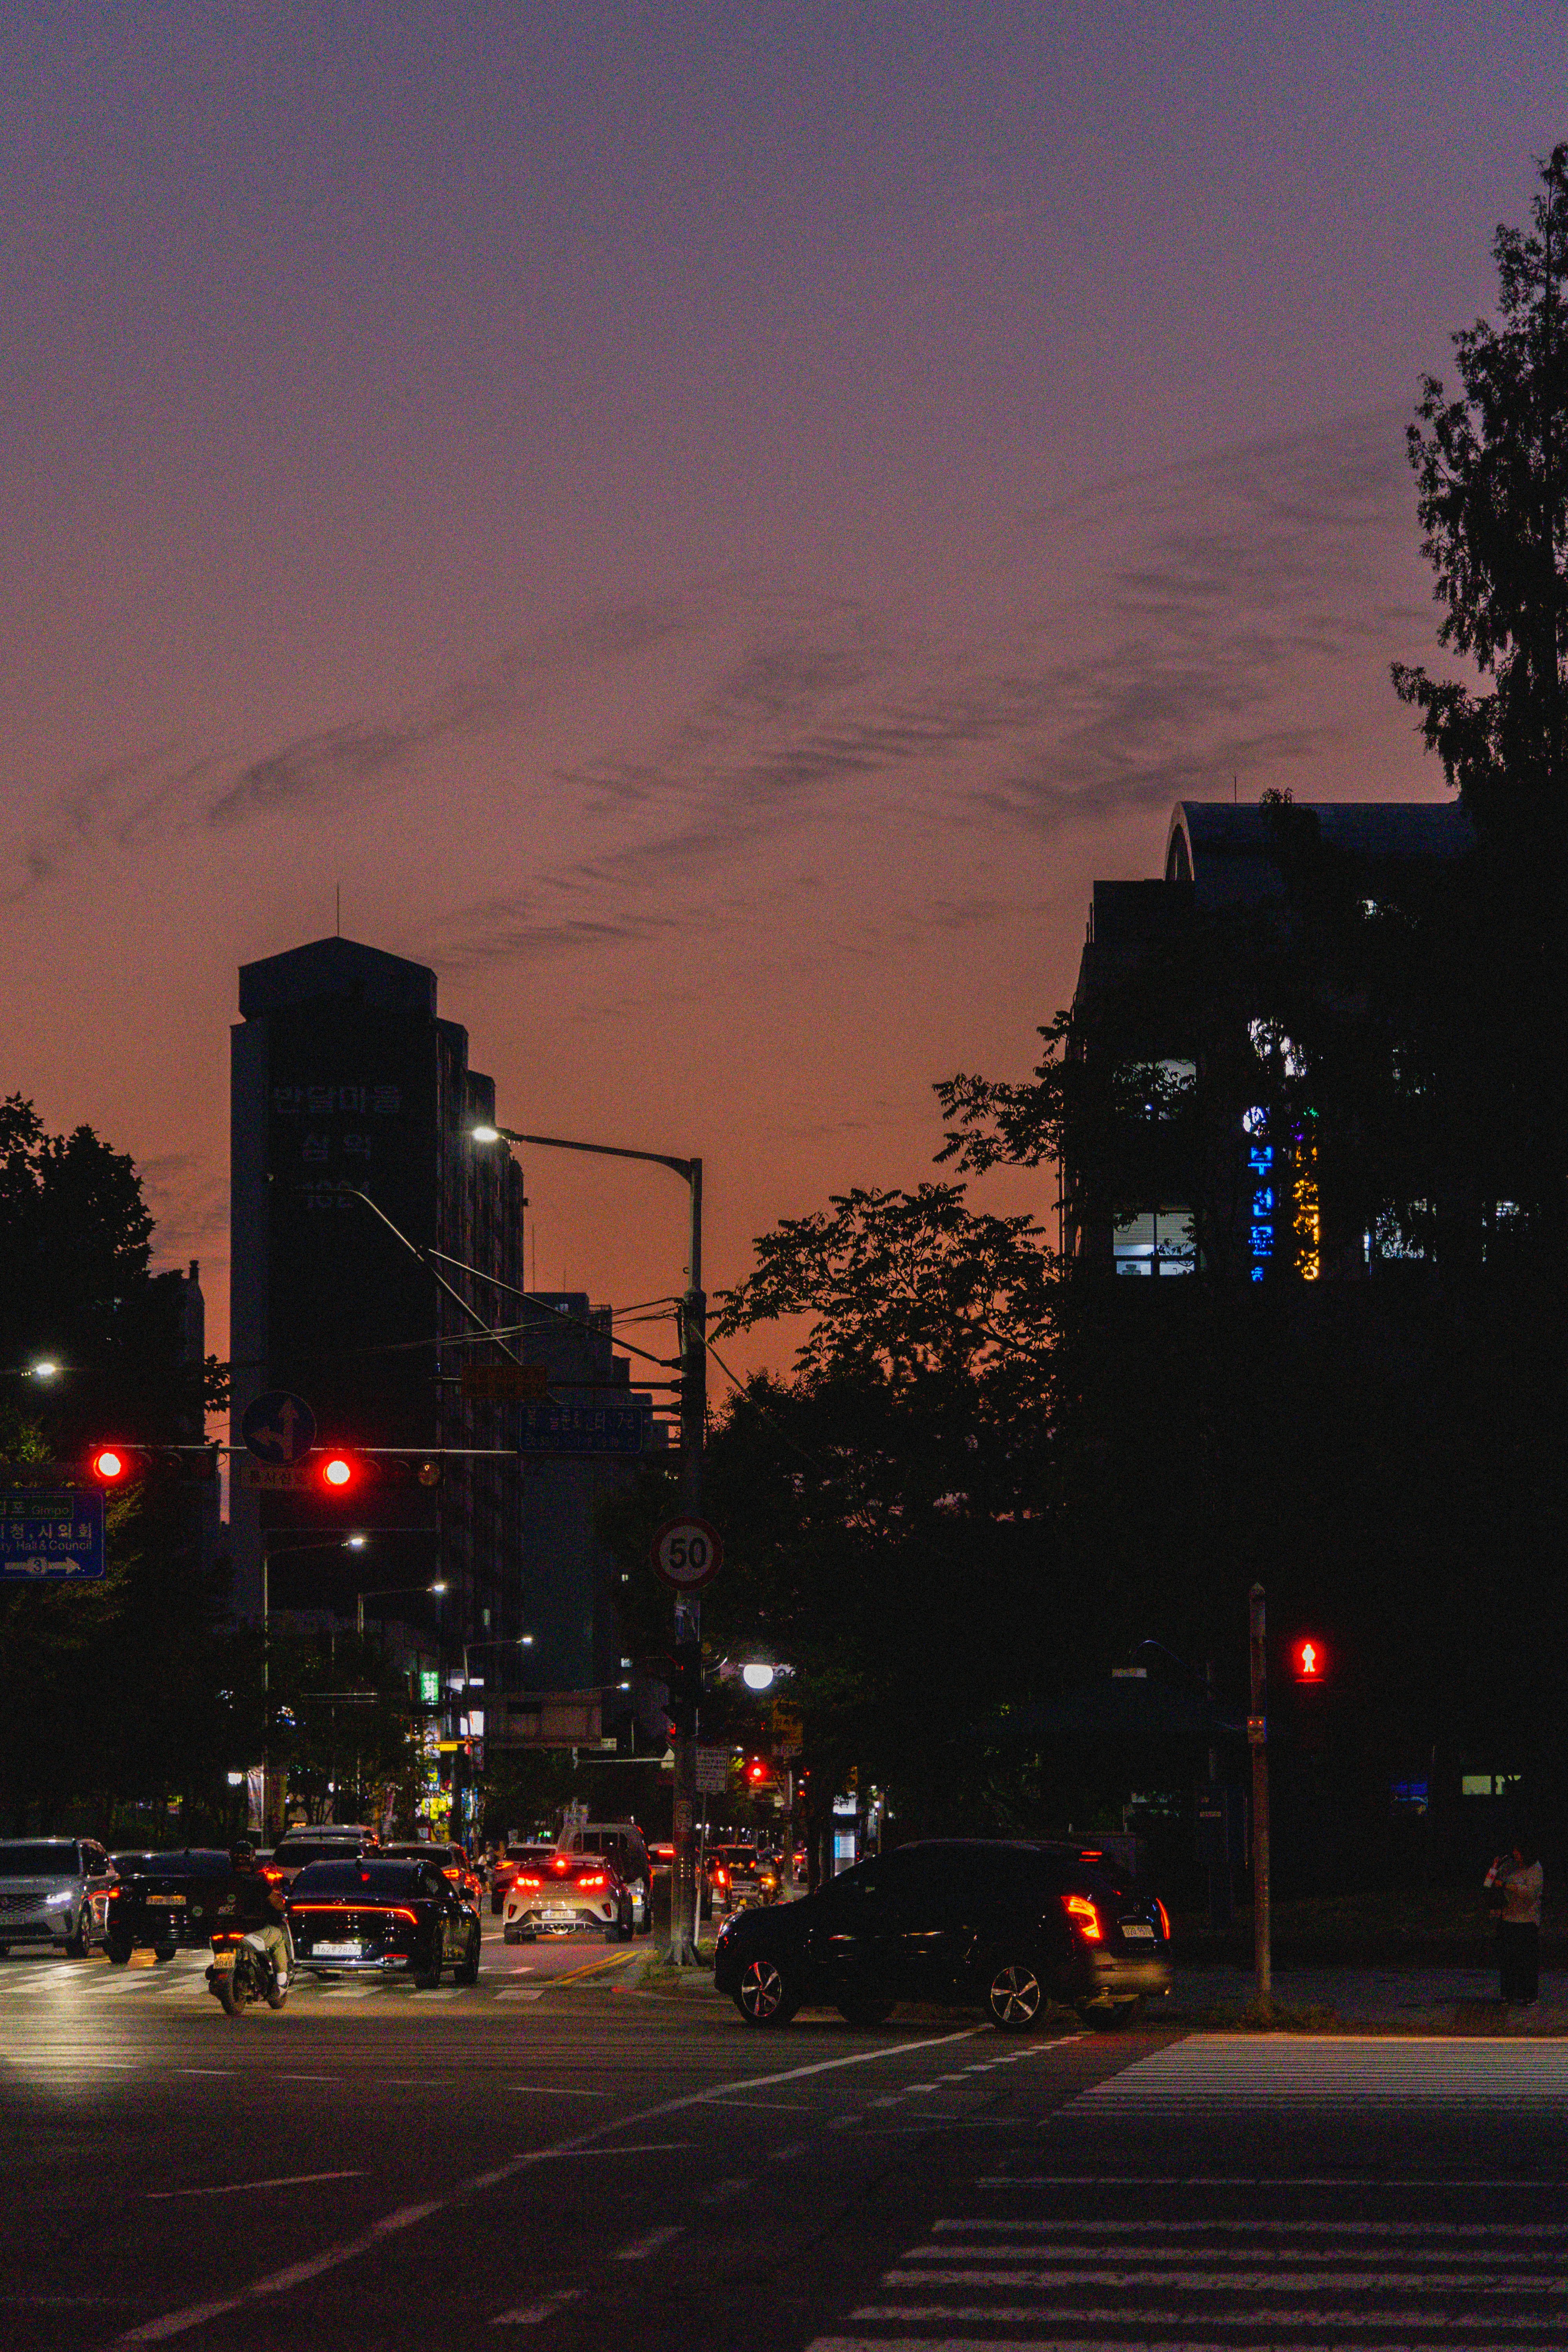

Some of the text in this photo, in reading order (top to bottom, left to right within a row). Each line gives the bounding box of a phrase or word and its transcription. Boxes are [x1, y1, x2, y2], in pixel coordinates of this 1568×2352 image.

[274, 1086, 403, 1114] 반달마을
[31, 1505, 69, 1515] Gimpo
[16, 1541, 38, 1550] Hall
[49, 1540, 92, 1550] Council
[669, 1537, 706, 1568] 50
[33, 1560, 42, 1572] 3
